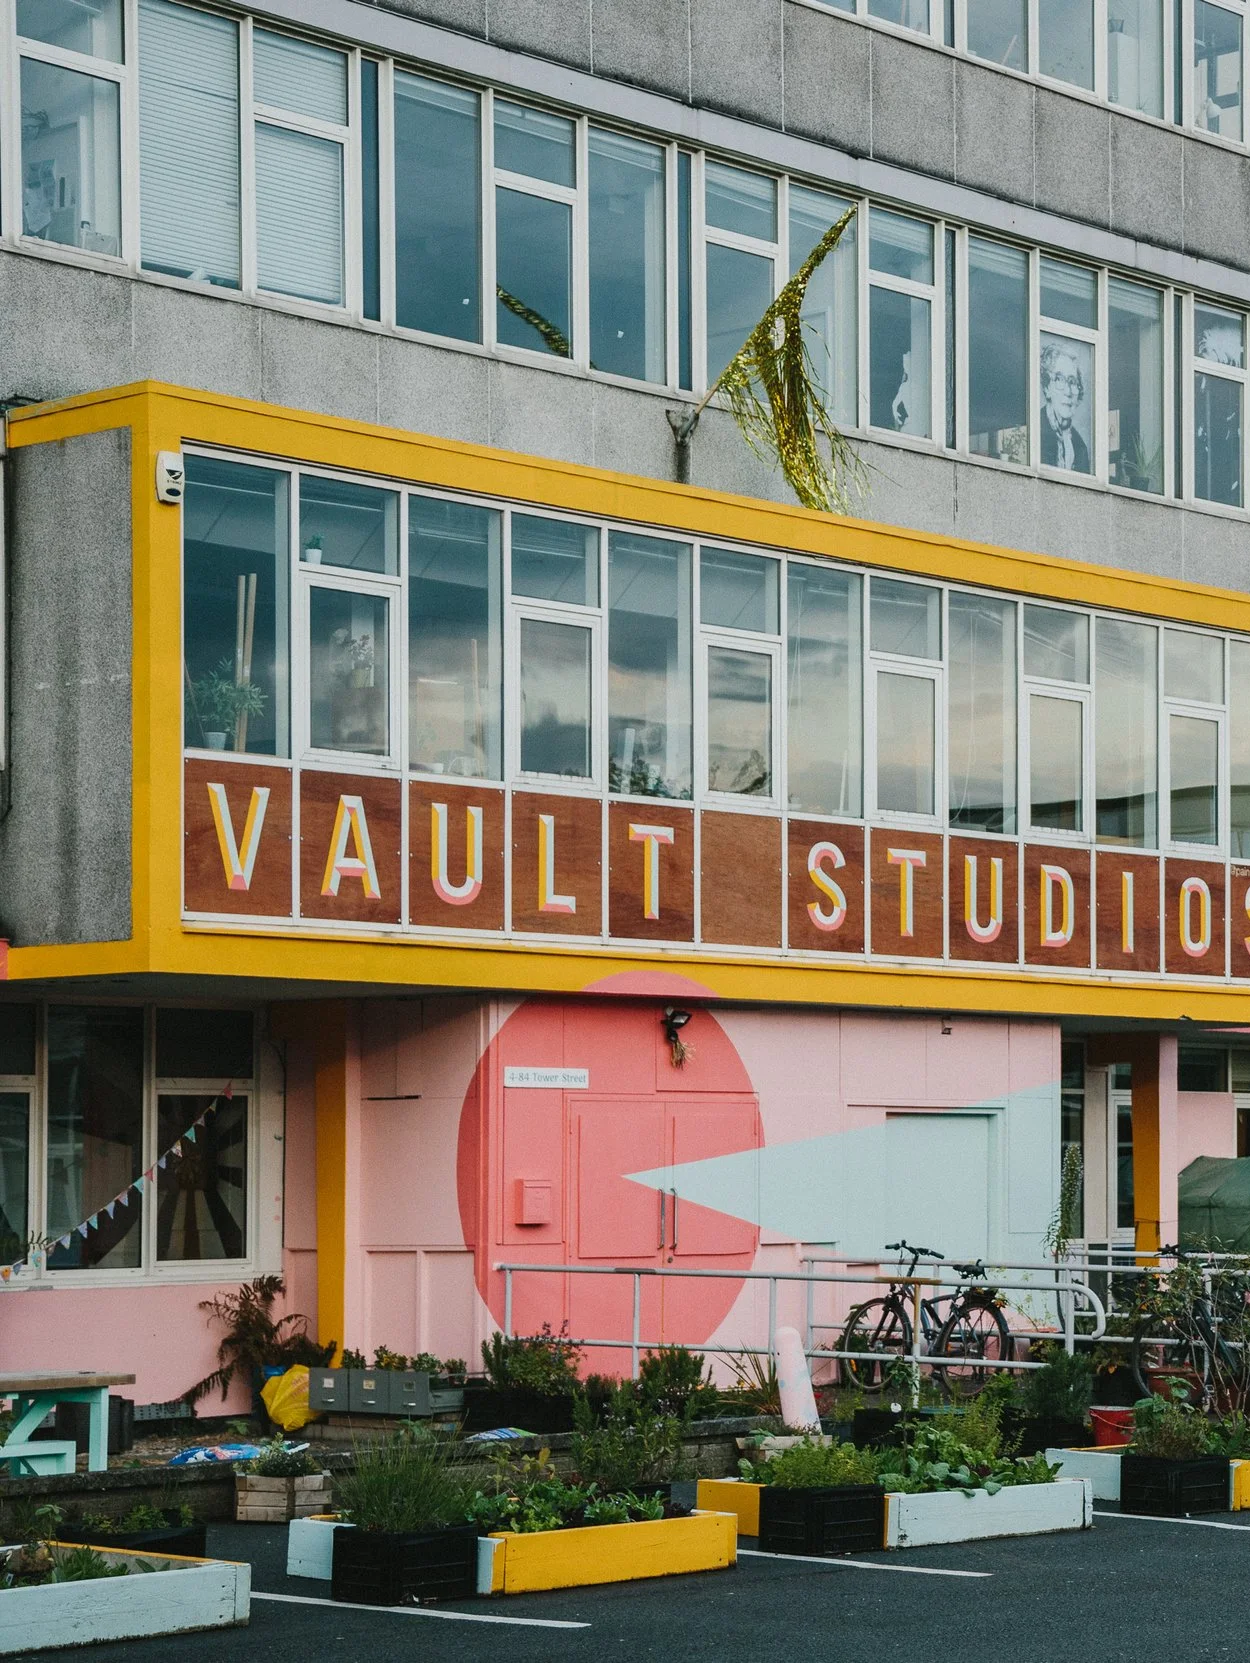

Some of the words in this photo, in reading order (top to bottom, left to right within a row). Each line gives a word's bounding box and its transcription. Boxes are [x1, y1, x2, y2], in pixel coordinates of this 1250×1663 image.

[207, 782, 674, 919] VAULT
[532, 1072, 558, 1082] Tower
[561, 1073, 586, 1084] Street
